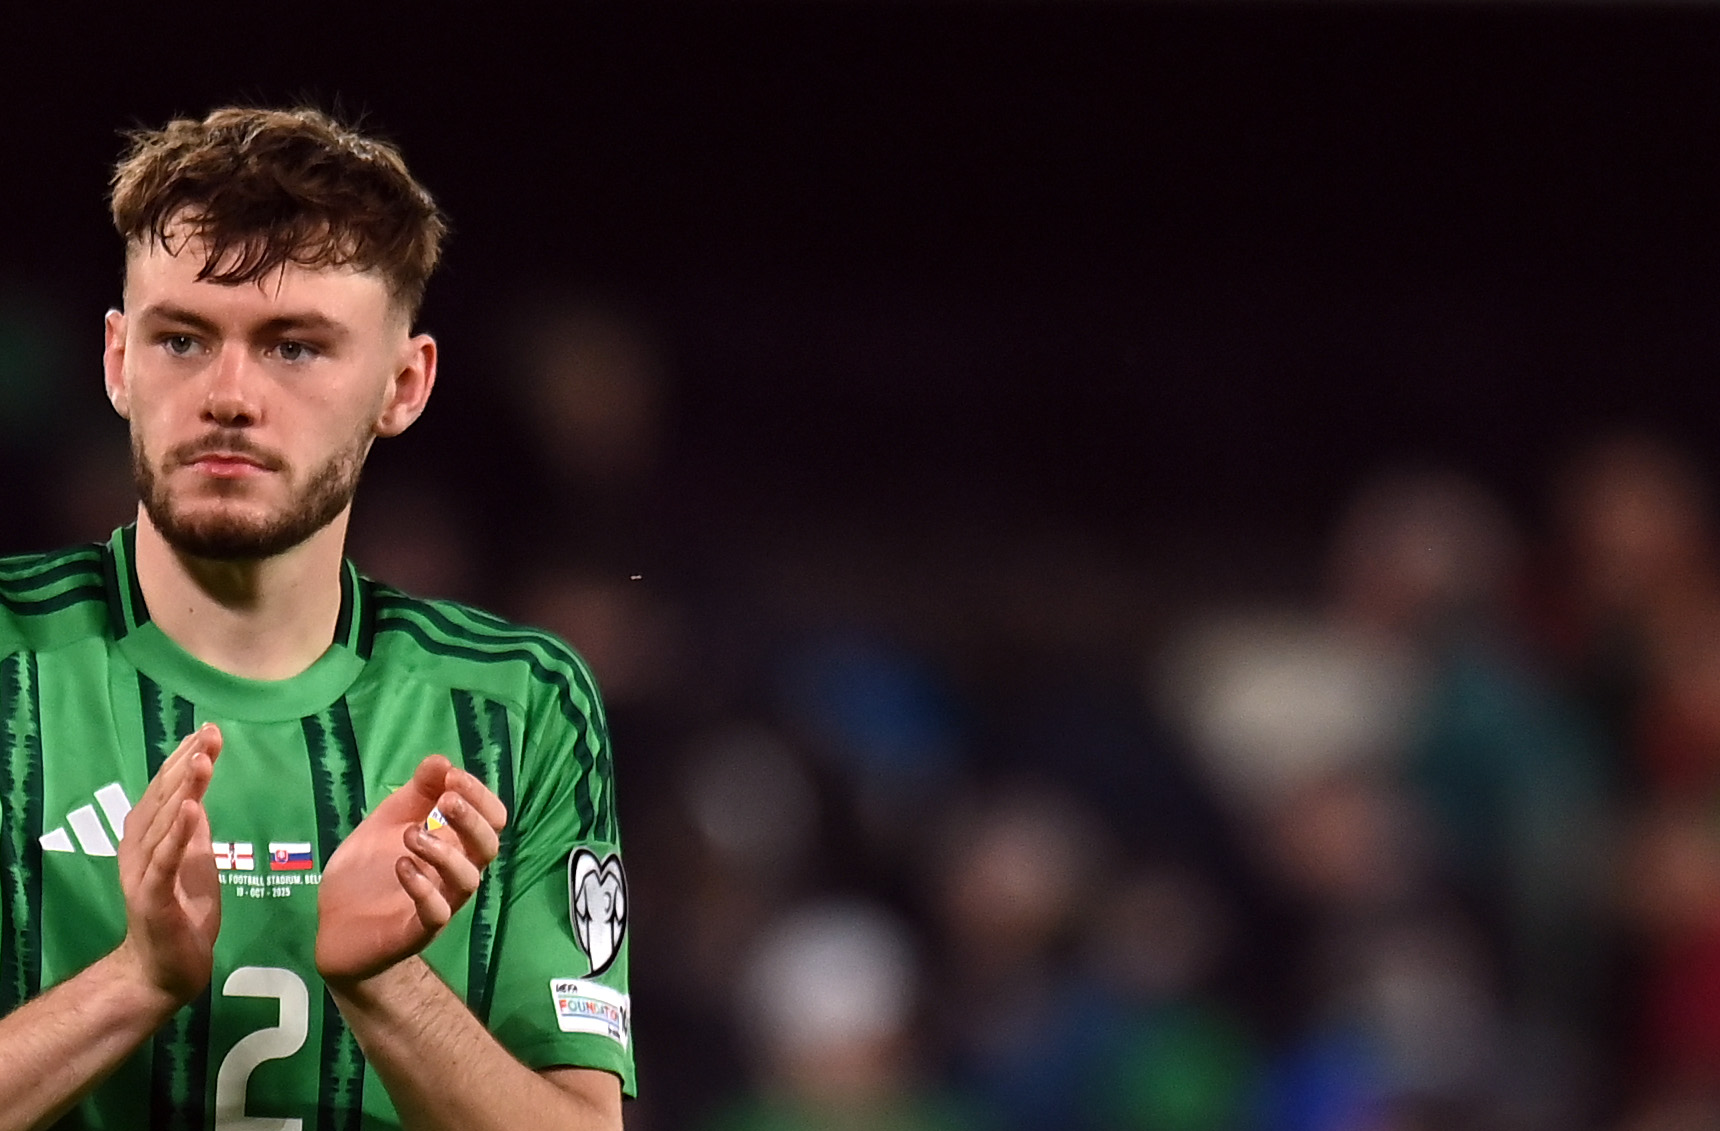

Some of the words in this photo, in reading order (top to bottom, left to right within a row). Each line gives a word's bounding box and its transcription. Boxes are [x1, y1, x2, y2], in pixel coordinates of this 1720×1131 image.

[228, 874, 265, 887] FOOTBALL
[250, 886, 265, 898] OCT
[272, 886, 291, 898] 2025
[555, 983, 578, 993] UEFA
